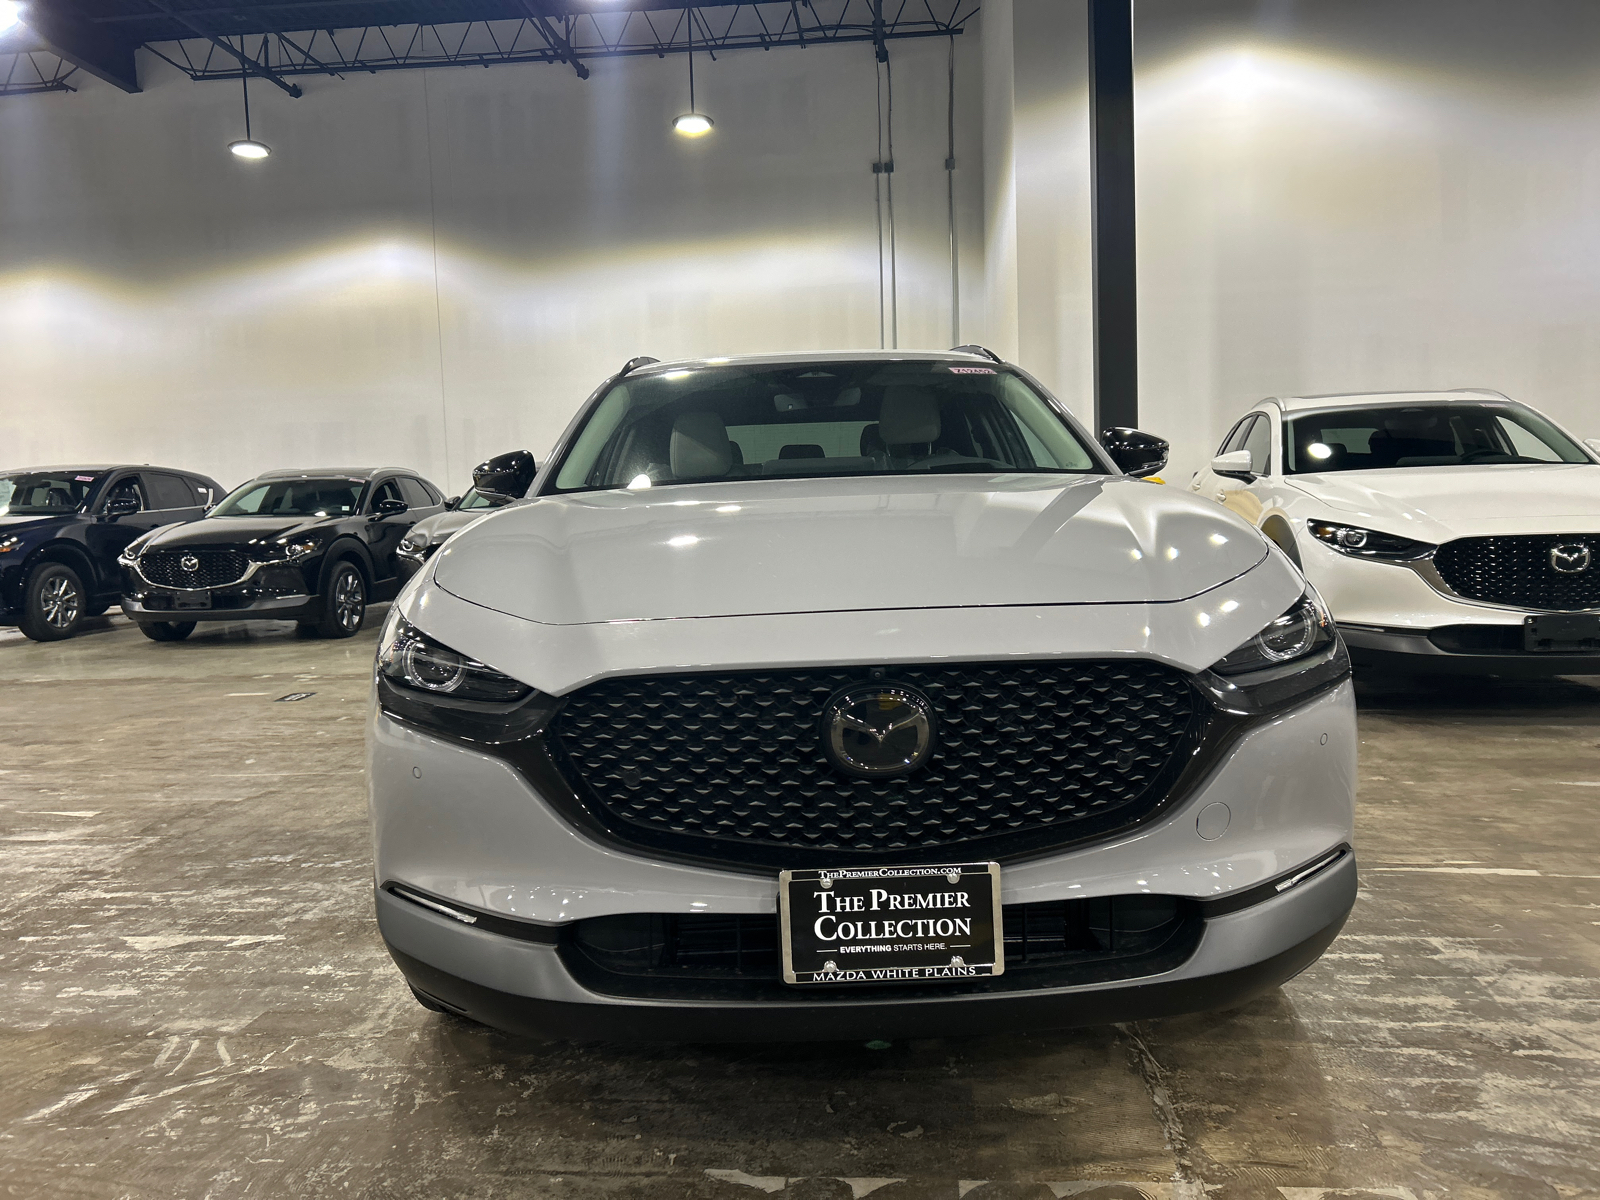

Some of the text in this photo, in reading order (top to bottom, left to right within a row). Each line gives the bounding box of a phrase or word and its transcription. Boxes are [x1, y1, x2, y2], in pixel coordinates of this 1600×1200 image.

[869, 888, 972, 911] PREMIER
[813, 915, 973, 941] COLLECTION
[839, 943, 948, 954] EVERYTHING STARTS HERE.
[812, 966, 976, 982] MAZDA WHITE PLAINS
